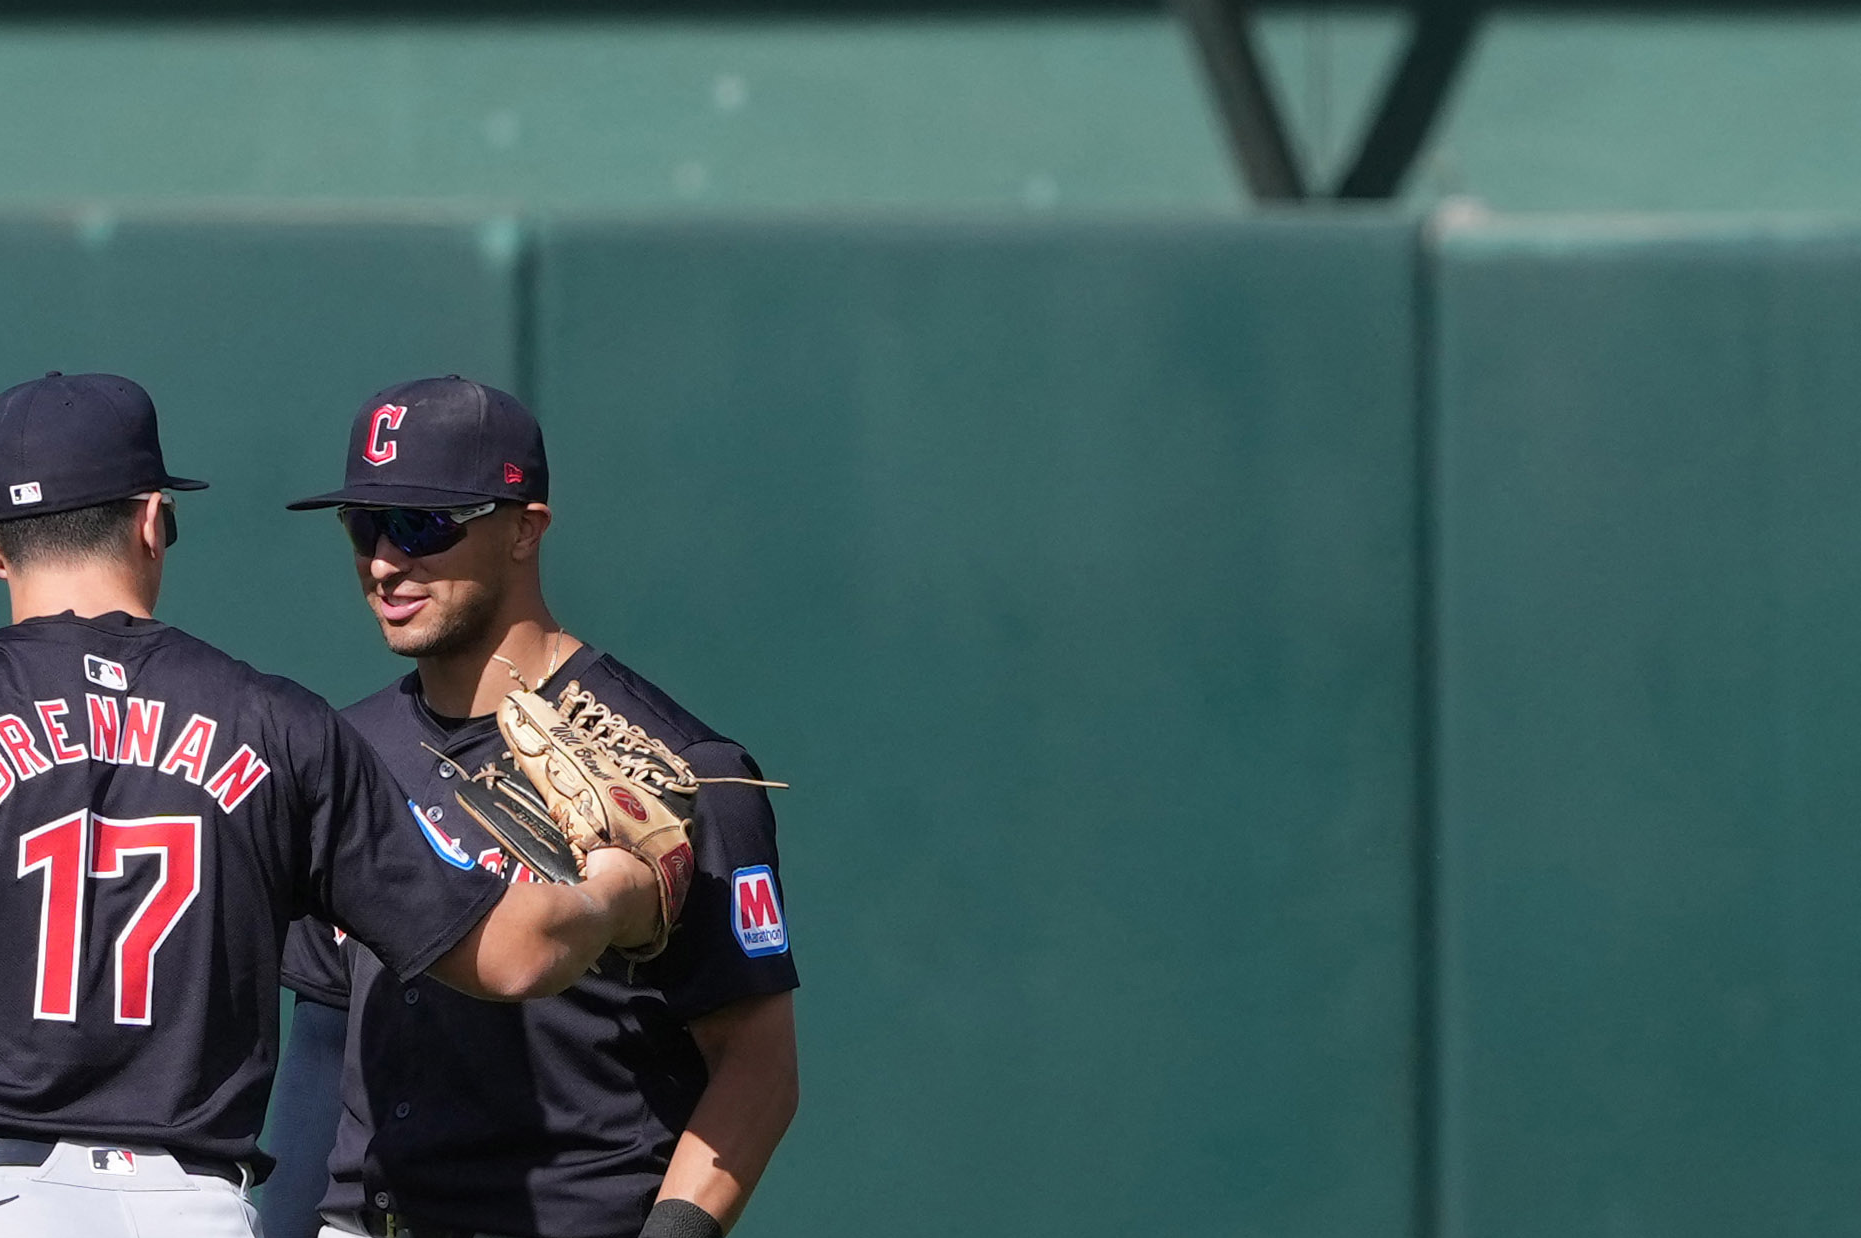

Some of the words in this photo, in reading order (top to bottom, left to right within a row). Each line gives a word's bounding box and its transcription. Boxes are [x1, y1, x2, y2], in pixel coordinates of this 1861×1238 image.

[362, 403, 408, 467] C
[17, 808, 202, 1026] 17
[739, 879, 779, 930] M
[743, 928, 782, 945] Marathon
